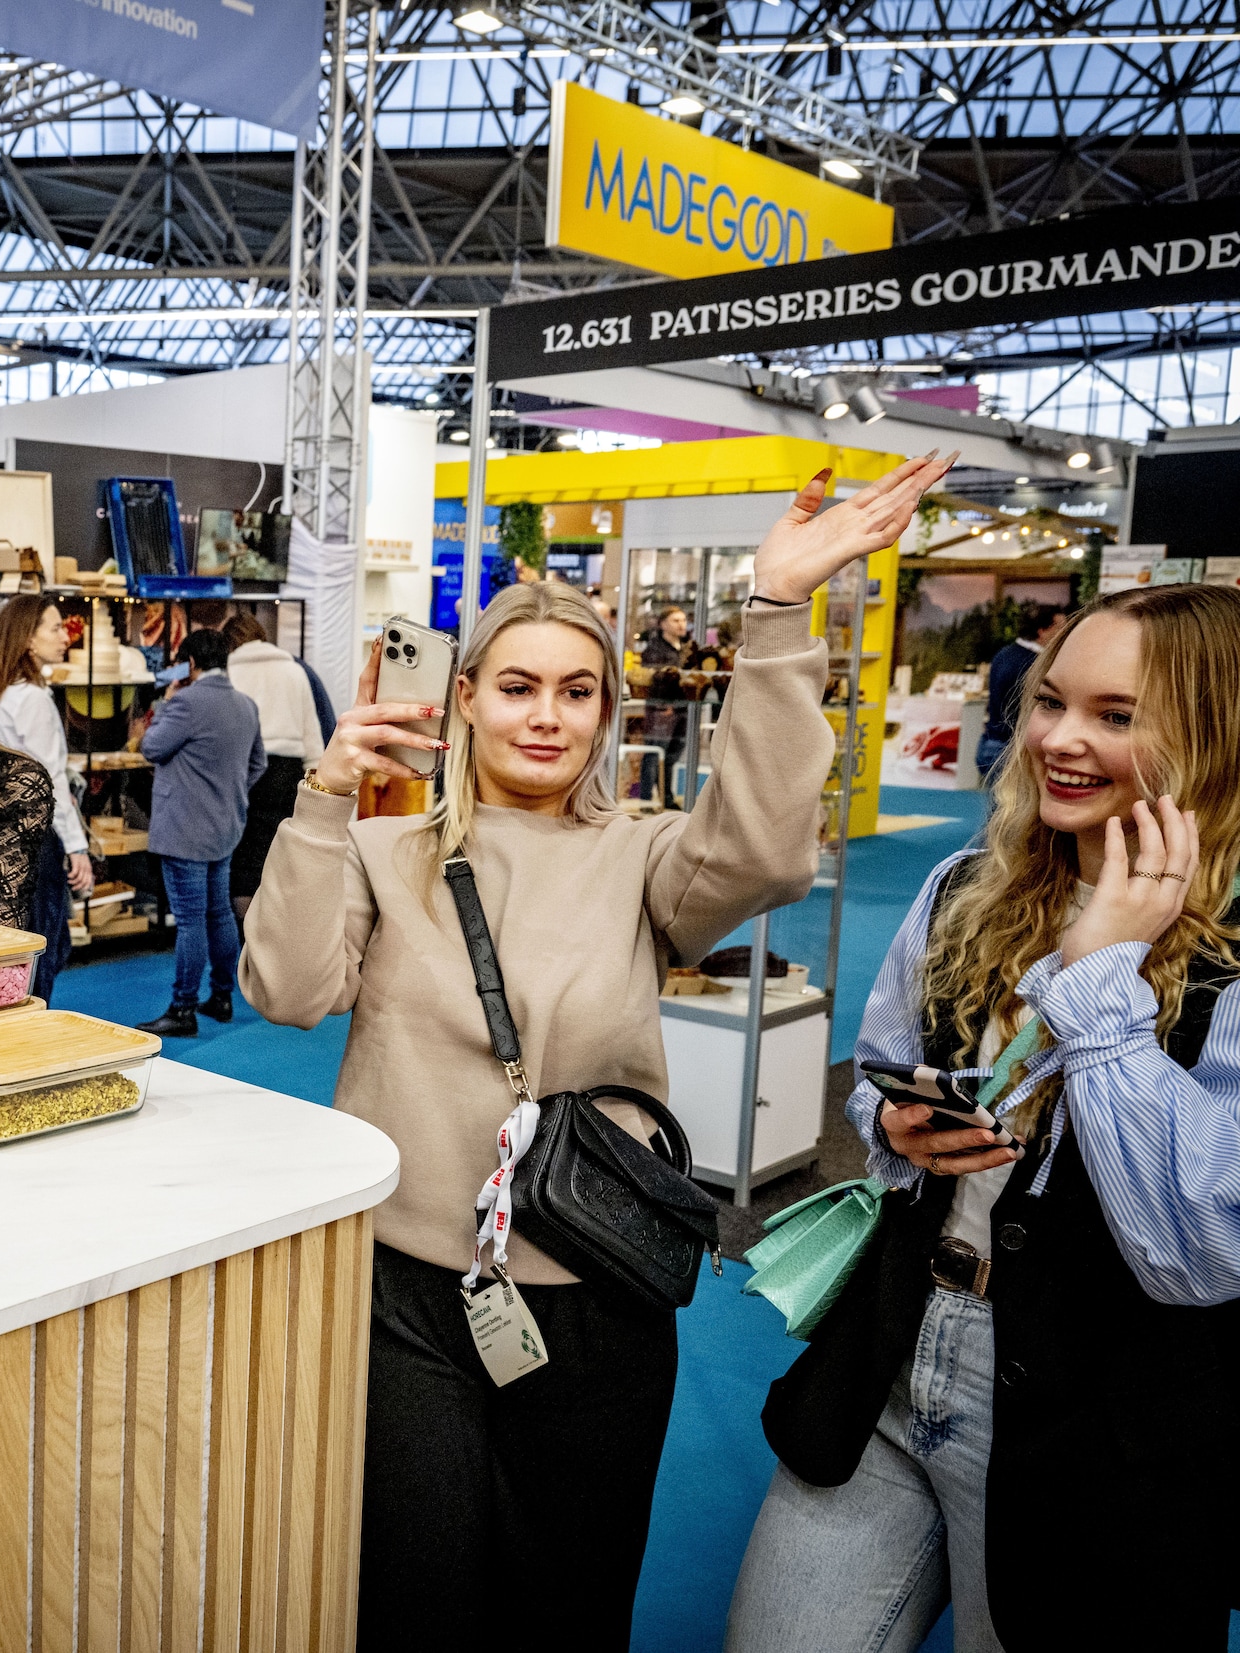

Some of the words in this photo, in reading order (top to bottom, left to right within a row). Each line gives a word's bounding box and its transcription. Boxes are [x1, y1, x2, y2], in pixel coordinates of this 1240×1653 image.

[585, 138, 807, 267] MADEGOOD
[543, 315, 632, 353] 12.631
[649, 279, 902, 341] PATISSERIES
[470, 1305, 492, 1322] HORECAVA
